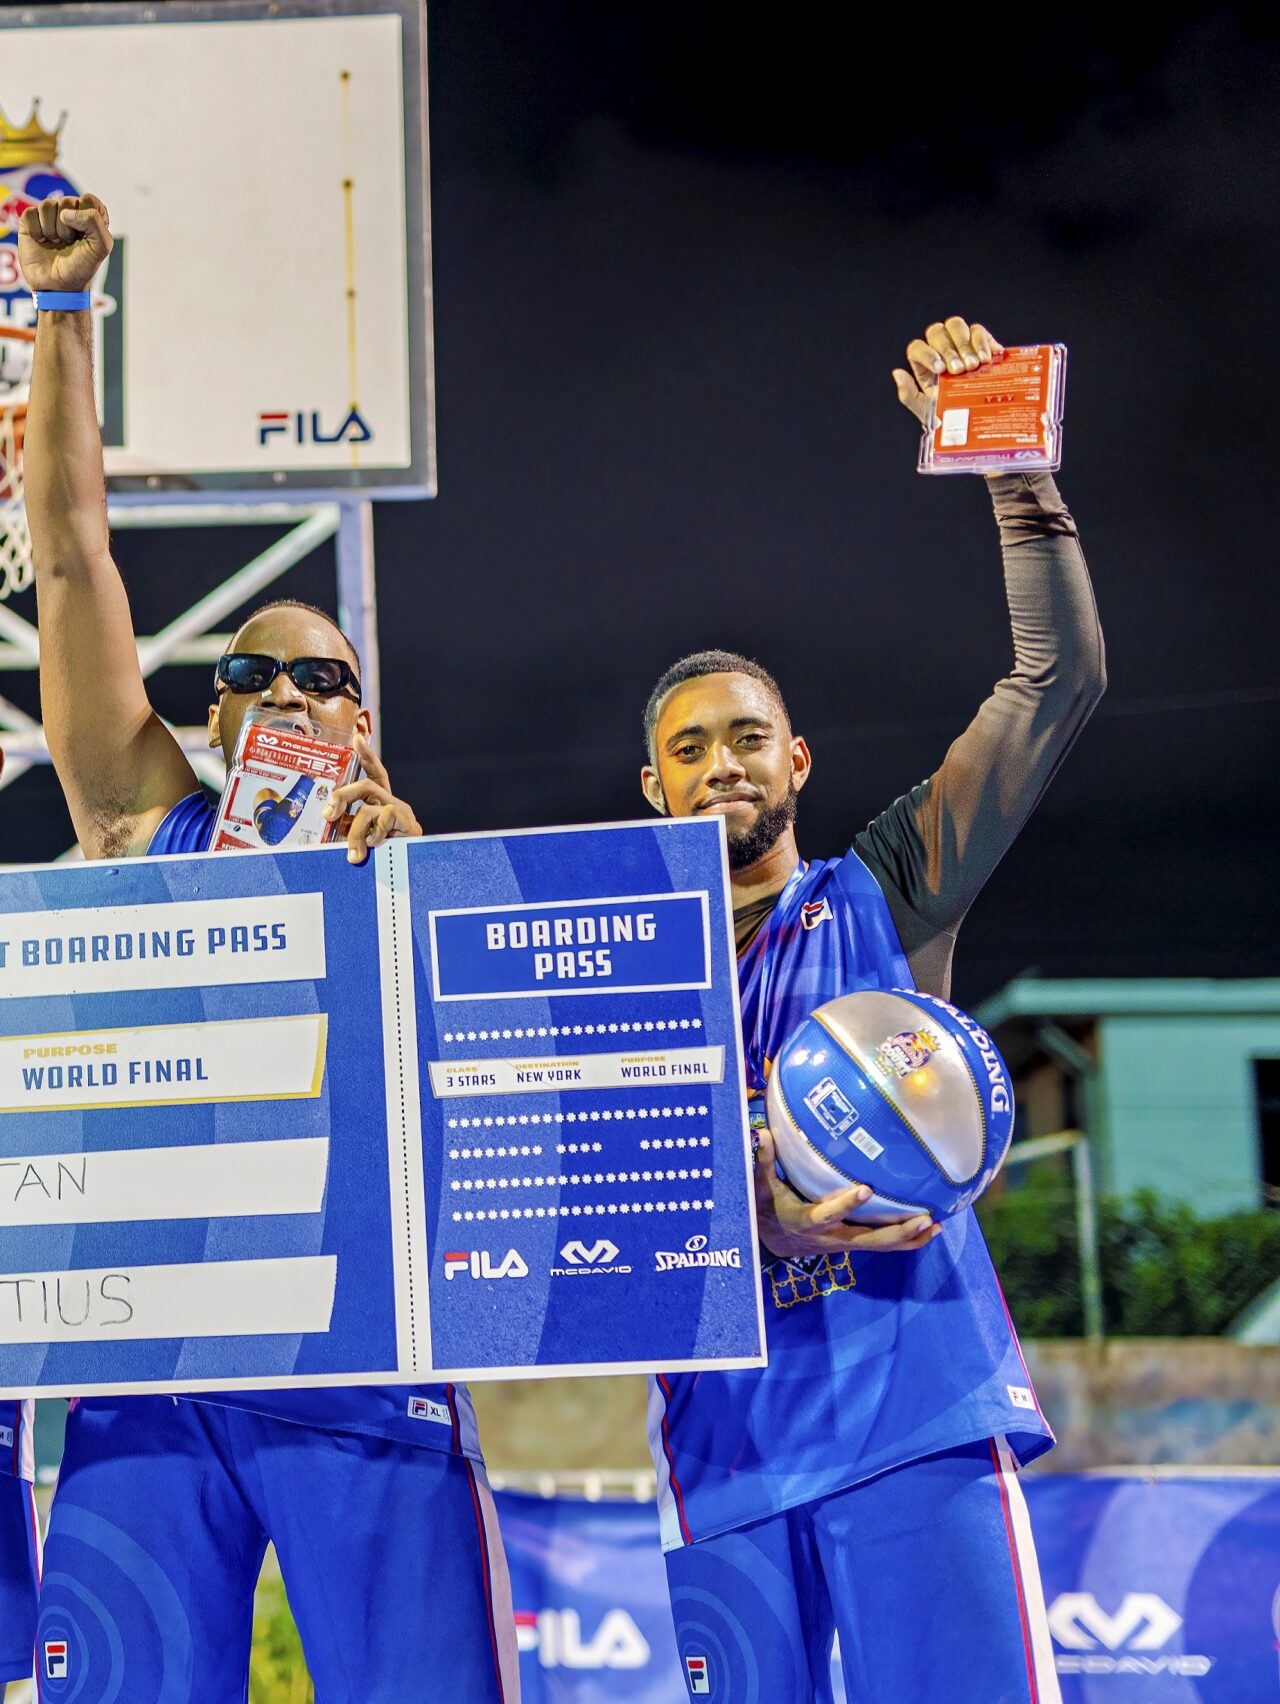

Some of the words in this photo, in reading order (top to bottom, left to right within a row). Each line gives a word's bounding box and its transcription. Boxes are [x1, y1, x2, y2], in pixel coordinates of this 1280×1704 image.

[260, 411, 371, 444] FILA
[297, 756, 342, 775] HEX
[21, 928, 195, 967] BOARDING
[207, 923, 288, 955] PASS
[486, 913, 656, 950] BOARDING
[534, 948, 613, 980] PASS
[22, 1042, 118, 1060] PURPOSE
[446, 1066, 478, 1074] CLASS
[514, 1060, 579, 1070] DESTINATION
[620, 1055, 666, 1064] PURPOSE
[21, 1062, 118, 1091] WORLD
[128, 1057, 209, 1085] FINAL
[446, 1076, 454, 1088] 3
[458, 1073, 496, 1087] STARS
[516, 1070, 544, 1083] NEW
[551, 1069, 587, 1082] YORK
[620, 1064, 666, 1078] WORLD
[671, 1062, 709, 1076] FINAL
[444, 1248, 529, 1281] FILA
[655, 1247, 742, 1272] SPALDING
[430, 1406, 441, 1416] XL
